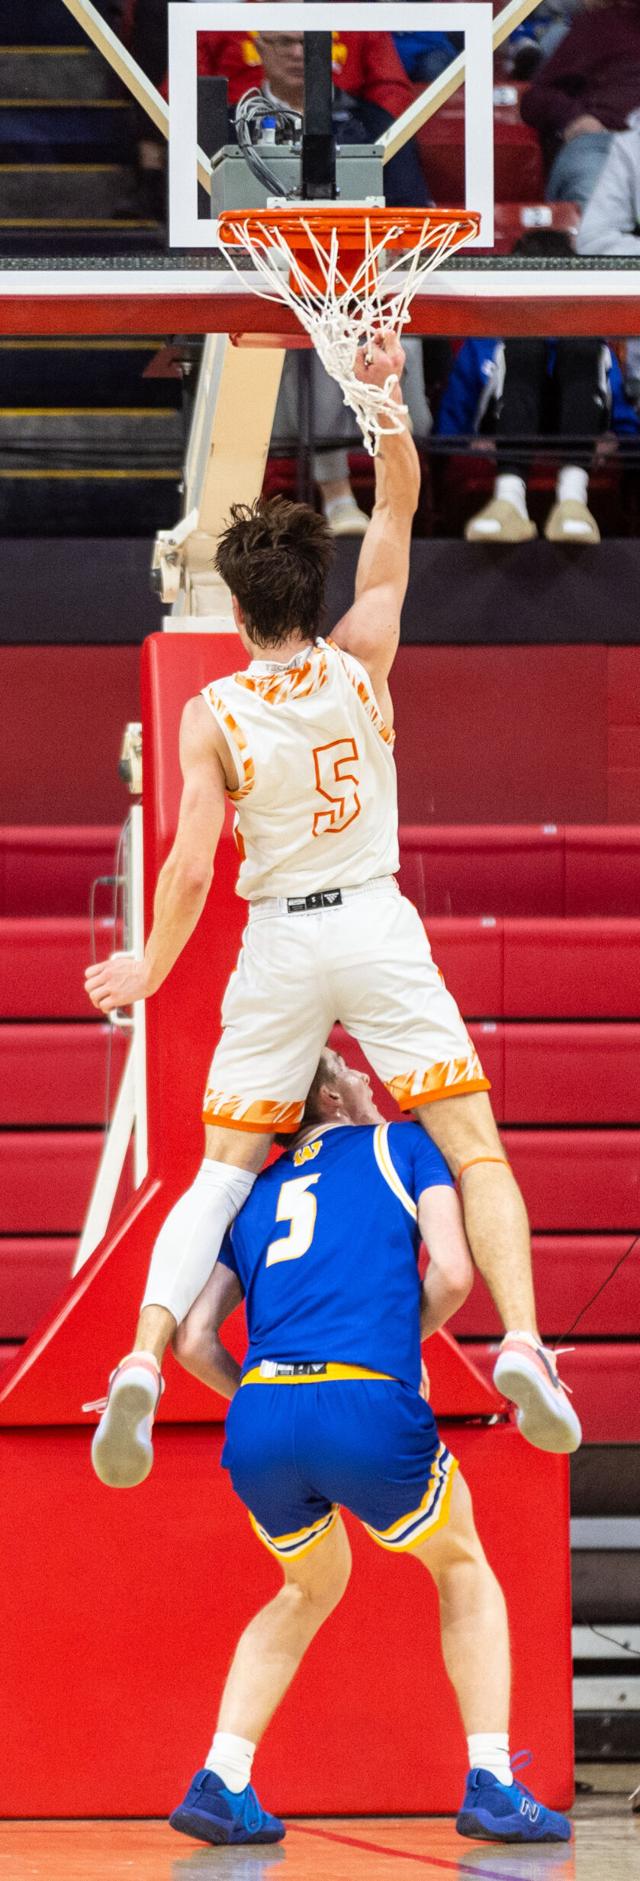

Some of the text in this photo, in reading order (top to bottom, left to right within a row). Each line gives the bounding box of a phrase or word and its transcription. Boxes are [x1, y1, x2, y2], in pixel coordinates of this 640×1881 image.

[312, 737, 362, 838] 5
[293, 1140, 323, 1167] W
[265, 1172, 322, 1269] 5
[520, 1797, 540, 1823] N
